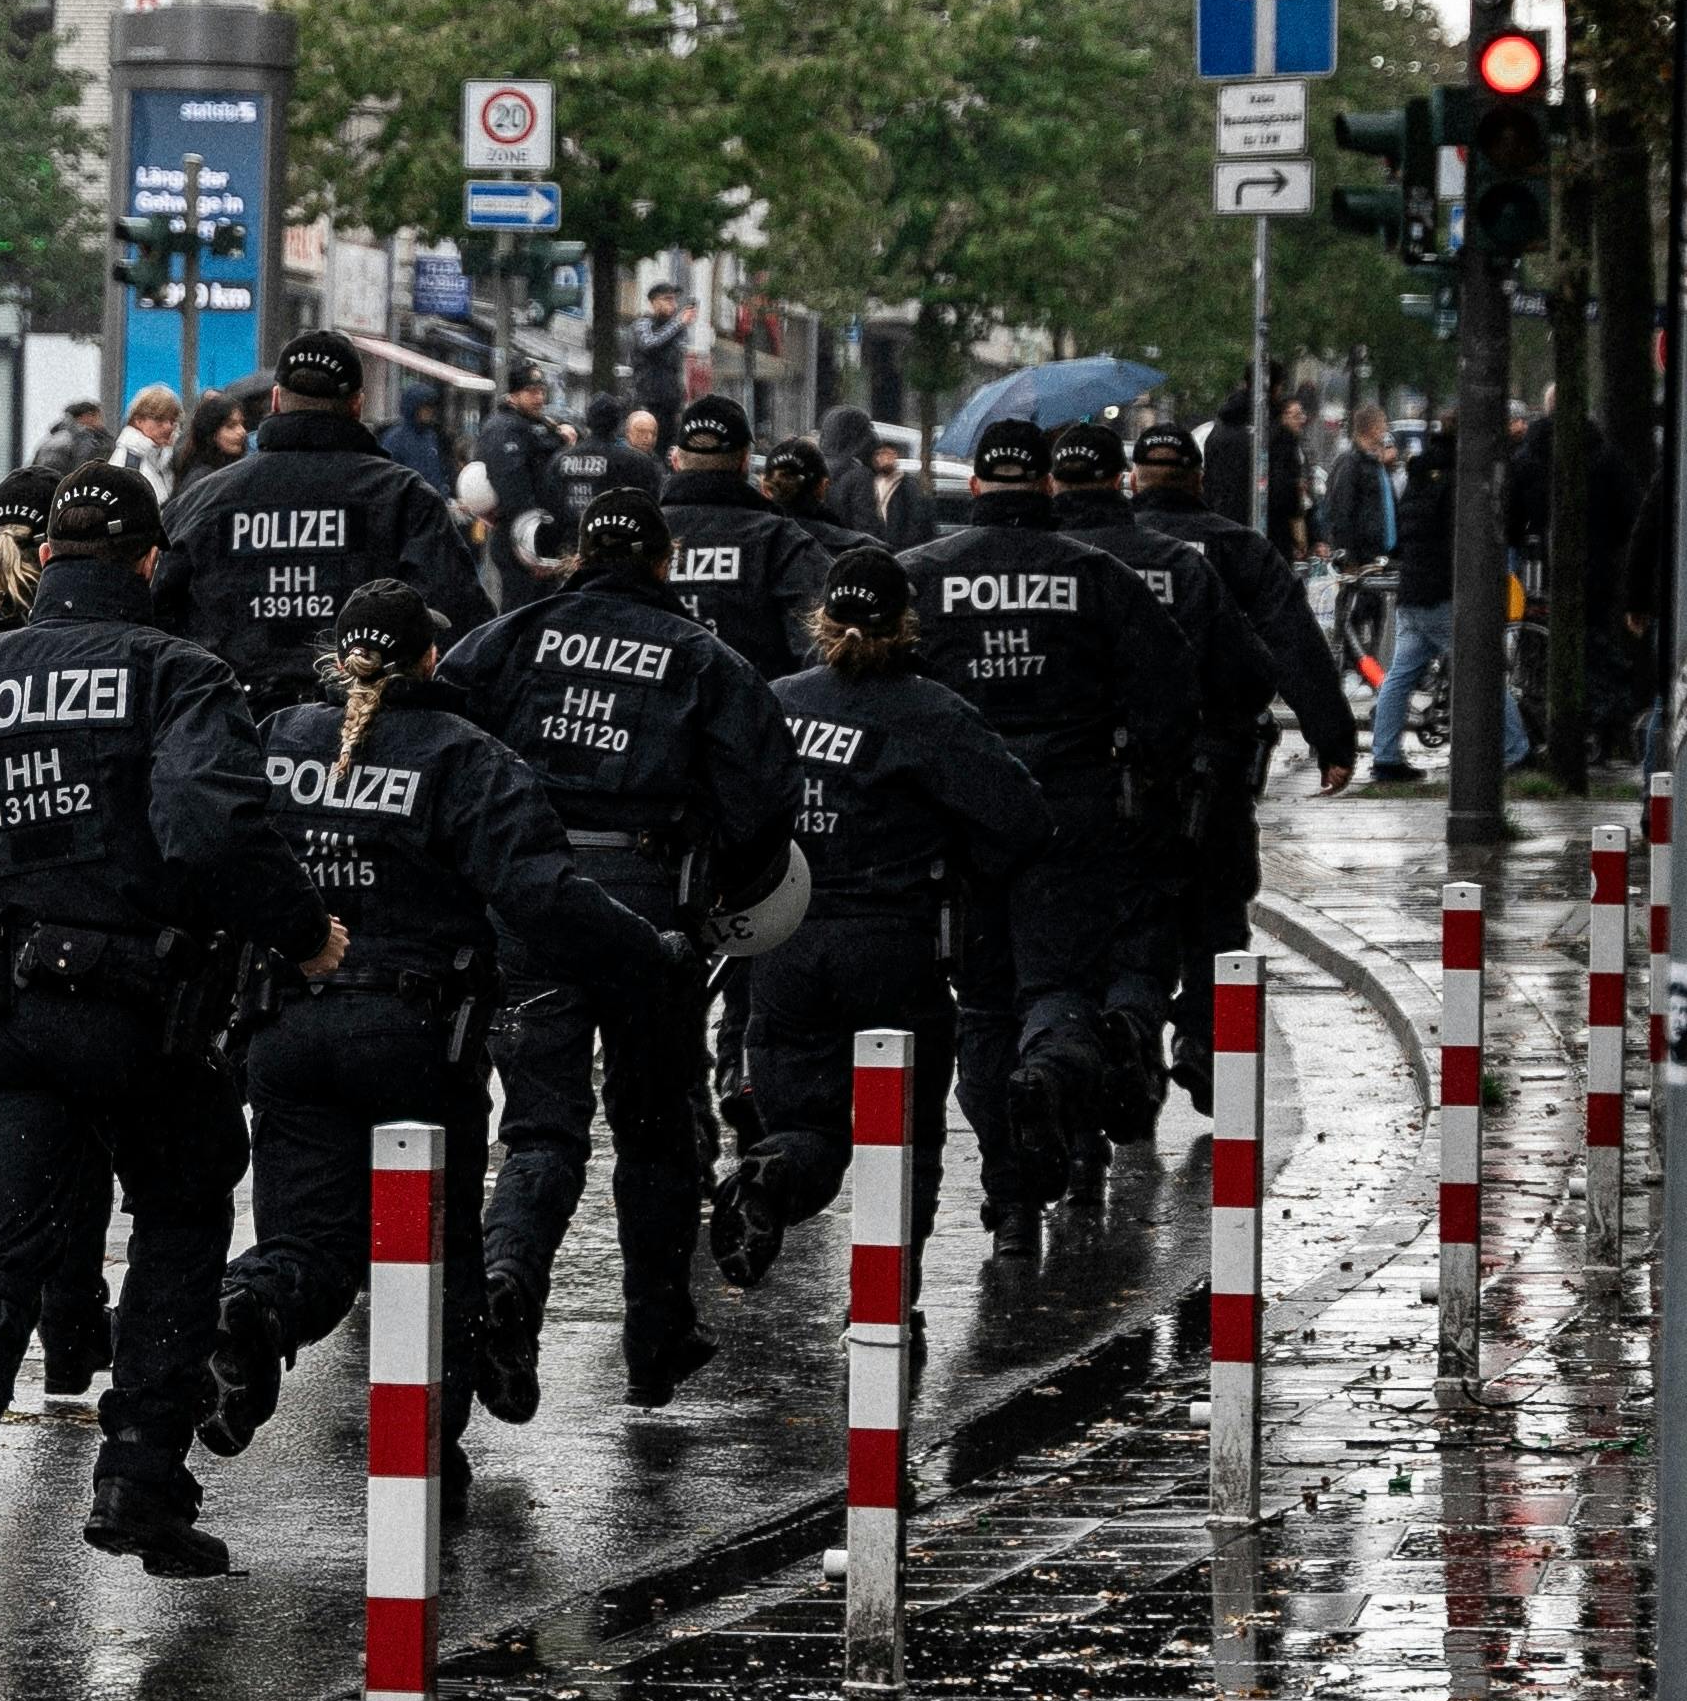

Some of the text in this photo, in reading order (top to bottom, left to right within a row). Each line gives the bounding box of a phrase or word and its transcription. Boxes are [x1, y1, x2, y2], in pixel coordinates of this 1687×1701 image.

[494, 102, 528, 130] 20
[486, 148, 528, 163] ZONE
[136, 166, 188, 192] Läng
[135, 191, 223, 218] Gehwge
[288, 351, 344, 374] POLIZEI
[683, 418, 728, 435] POLIZEI
[561, 455, 608, 476] POLIZEI
[985, 446, 1033, 463] POLIZEI
[1056, 445, 1100, 461] POLIZEI
[56, 482, 118, 510] POLIZEI
[232, 509, 346, 551] POLIZEI
[587, 514, 641, 533] POLIZEI
[669, 546, 741, 582] LIZEI
[268, 565, 316, 593] HH
[829, 584, 880, 606] POLIZEI
[942, 573, 1078, 613] POLIZEI
[249, 595, 334, 619] 139162
[535, 629, 673, 681] POLIZEI
[983, 629, 1030, 655] HH
[968, 655, 1046, 679] 131177
[562, 686, 616, 722] HH
[540, 714, 630, 754] 131120
[5, 747, 61, 790] HH
[265, 755, 421, 817] POLIZEI
[803, 777, 823, 807] H
[794, 809, 839, 834] 137
[301, 860, 376, 888] 1115
